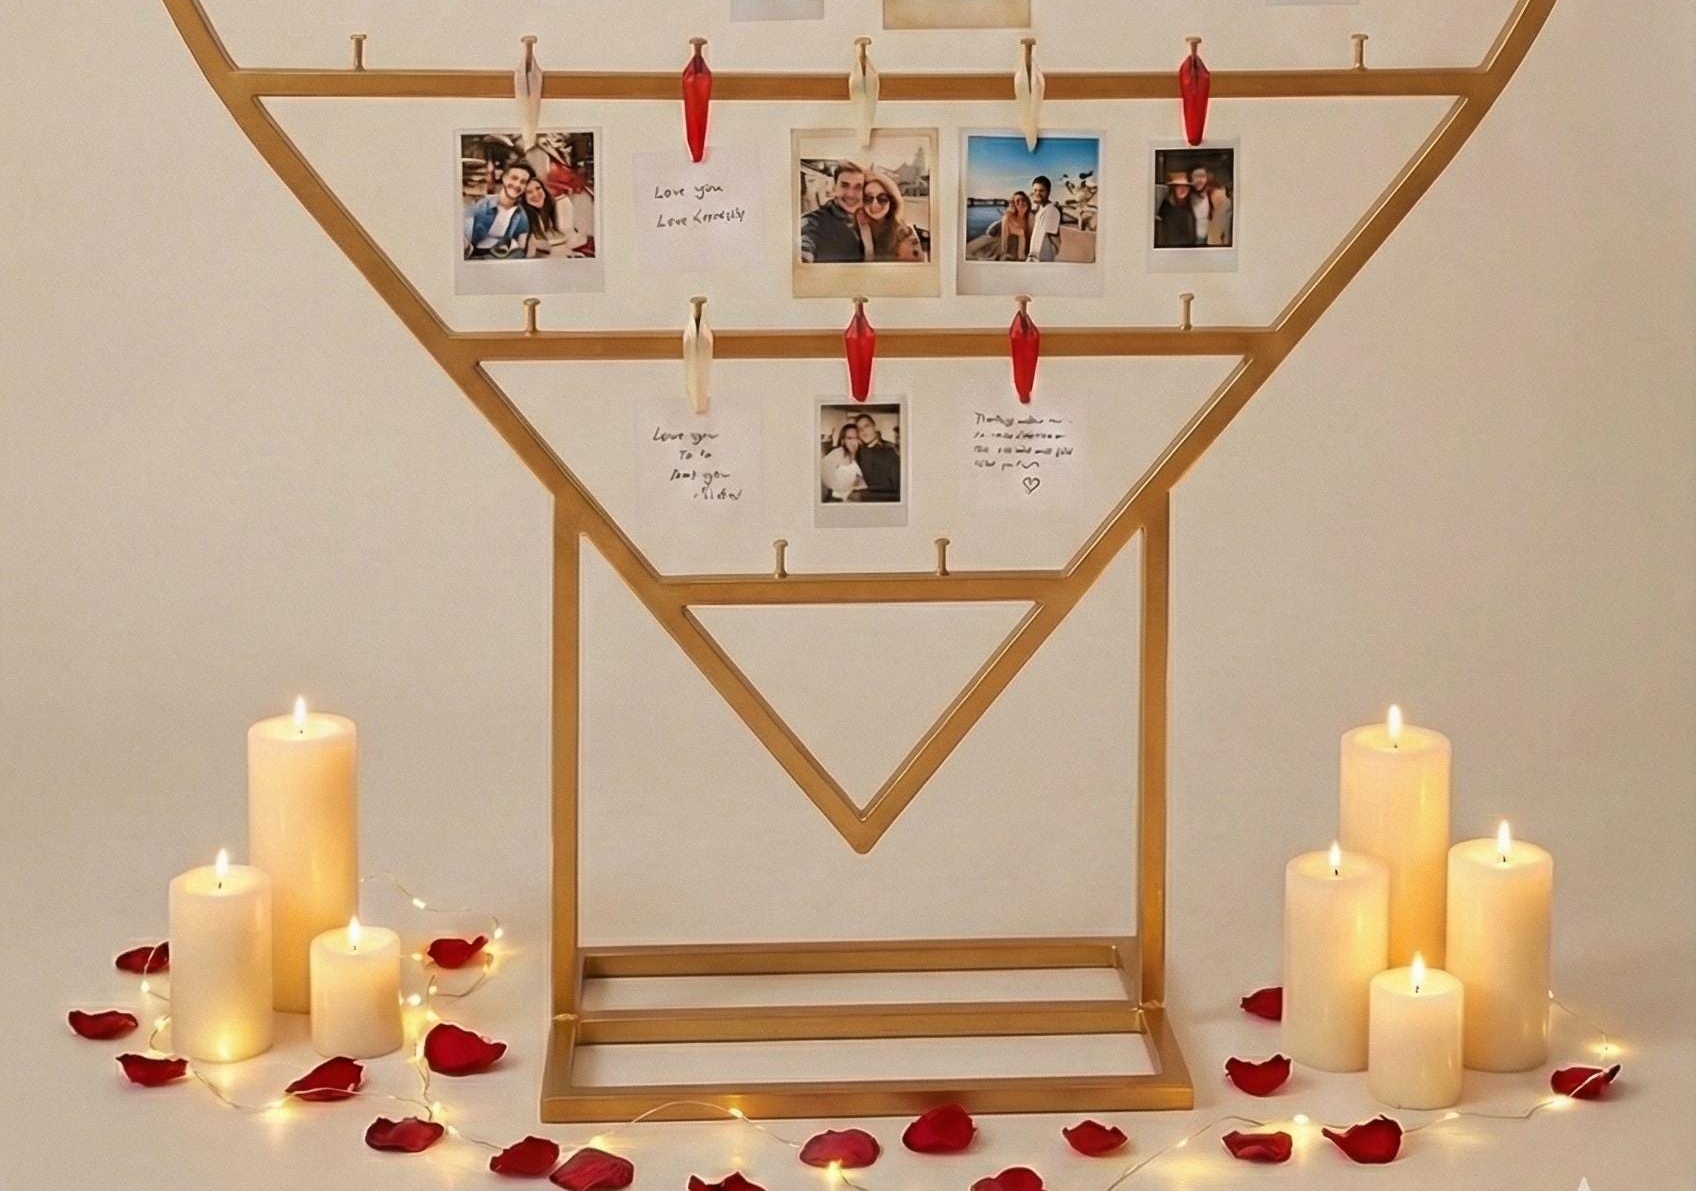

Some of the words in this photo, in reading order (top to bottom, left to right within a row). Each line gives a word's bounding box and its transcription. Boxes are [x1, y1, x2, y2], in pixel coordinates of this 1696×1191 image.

[654, 186, 685, 199] Love
[694, 183, 724, 200] you
[657, 214, 687, 228] Love
